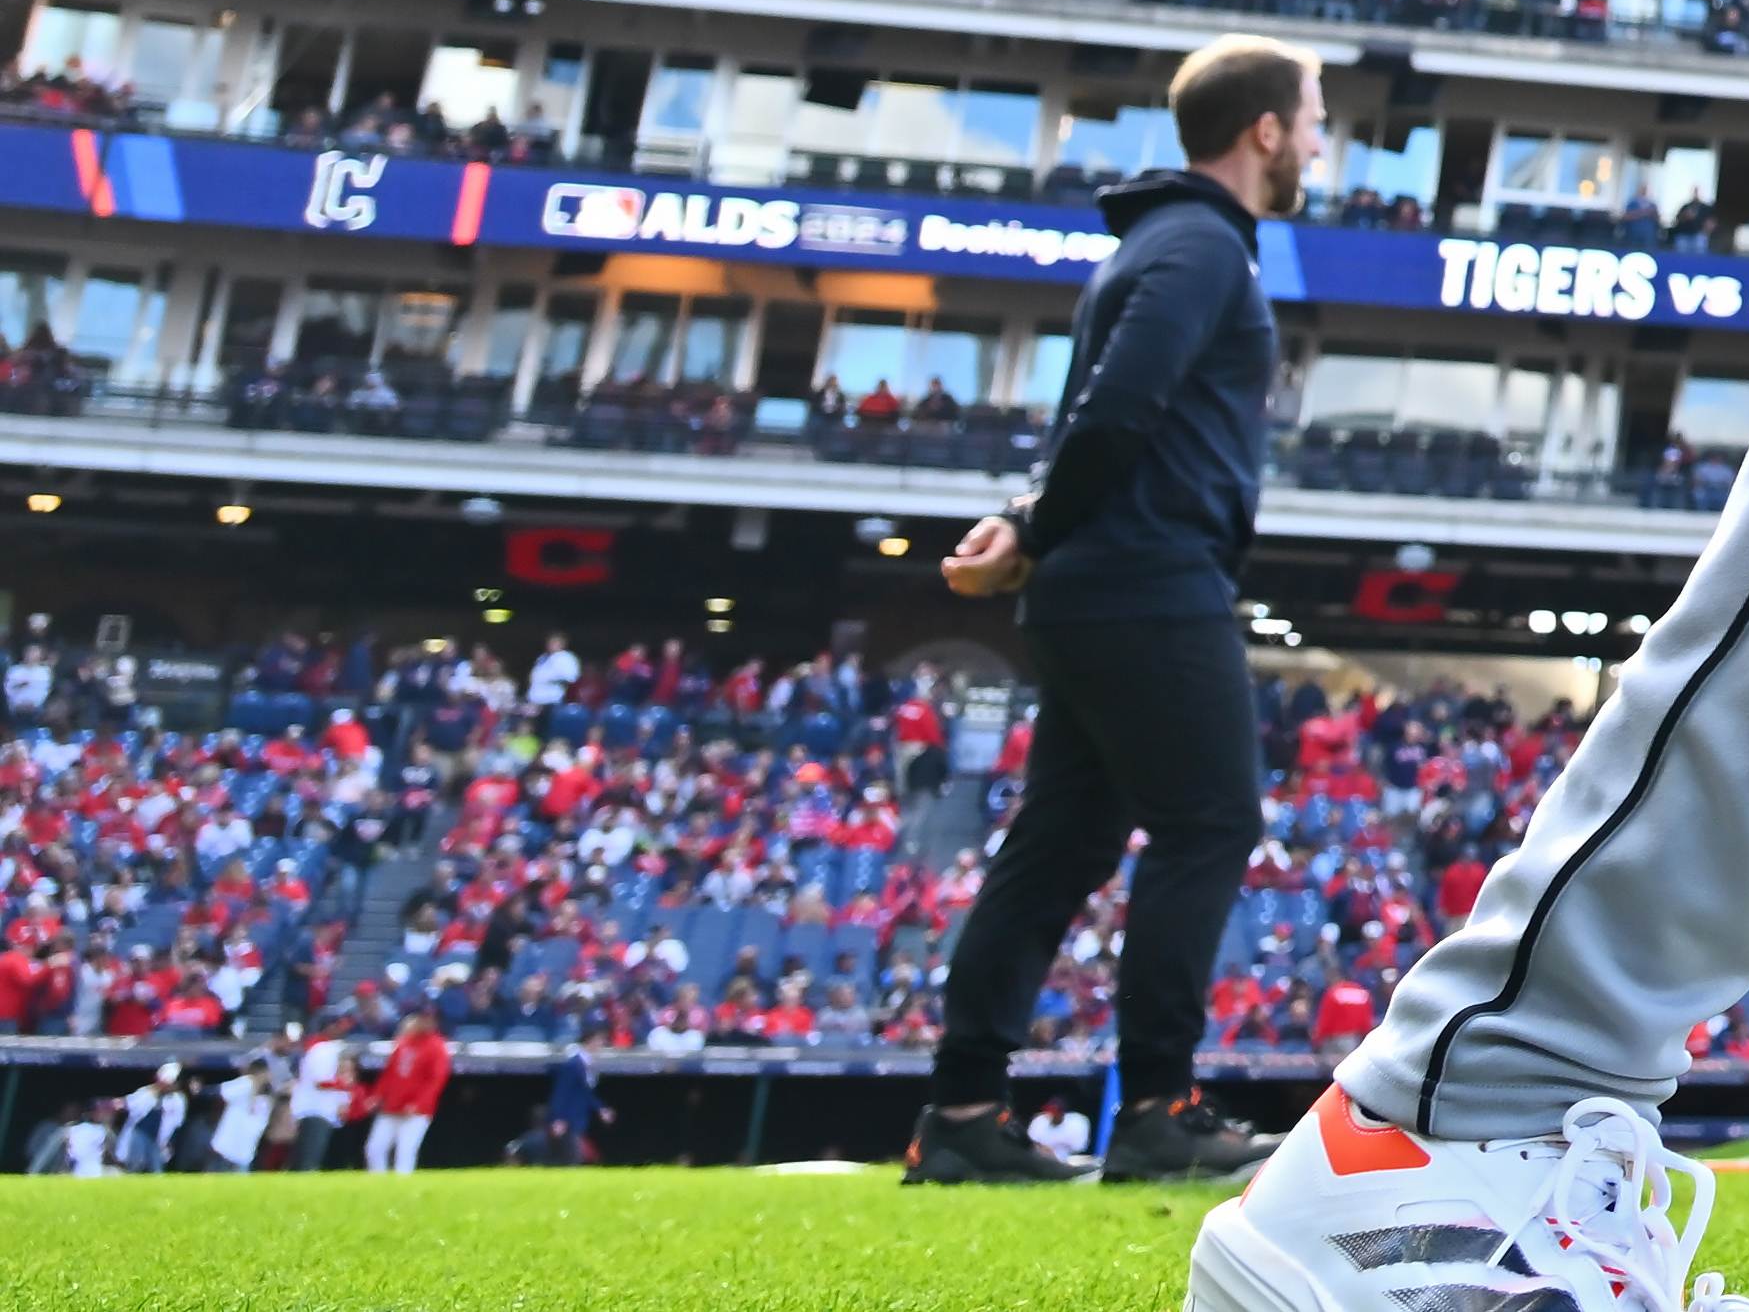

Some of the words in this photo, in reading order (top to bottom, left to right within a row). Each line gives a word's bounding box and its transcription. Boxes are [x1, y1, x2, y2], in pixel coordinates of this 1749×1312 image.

[639, 192, 801, 249] ALDS
[1438, 238, 1658, 320] TIGERS
[1668, 272, 1743, 318] vs
